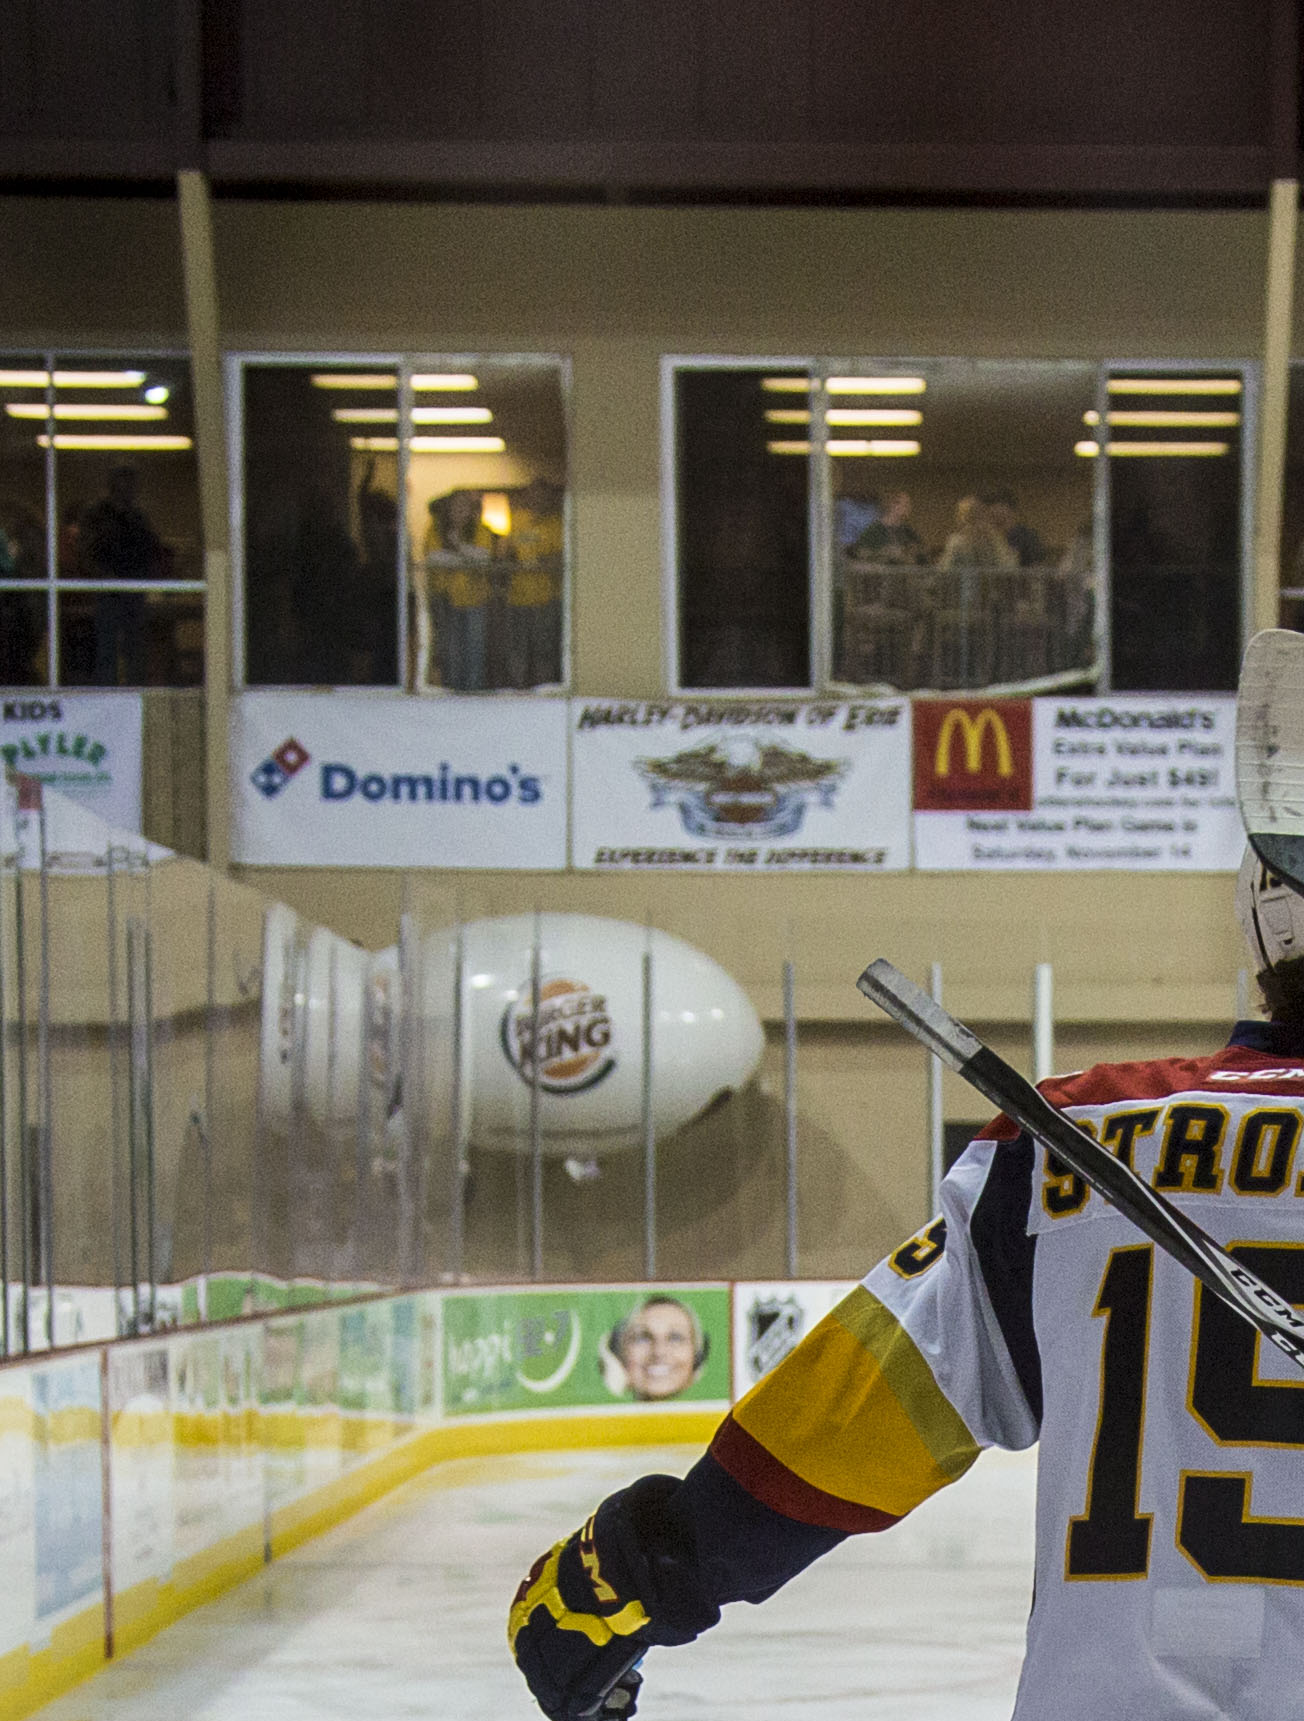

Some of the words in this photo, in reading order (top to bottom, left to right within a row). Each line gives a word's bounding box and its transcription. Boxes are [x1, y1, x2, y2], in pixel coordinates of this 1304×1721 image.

[1055, 706, 1216, 730] McDonald's
[1116, 738, 1170, 756] Value
[1176, 737, 1224, 756] Plan
[319, 761, 542, 803] Domino's
[1055, 766, 1098, 787] For
[1107, 766, 1161, 788] Just
